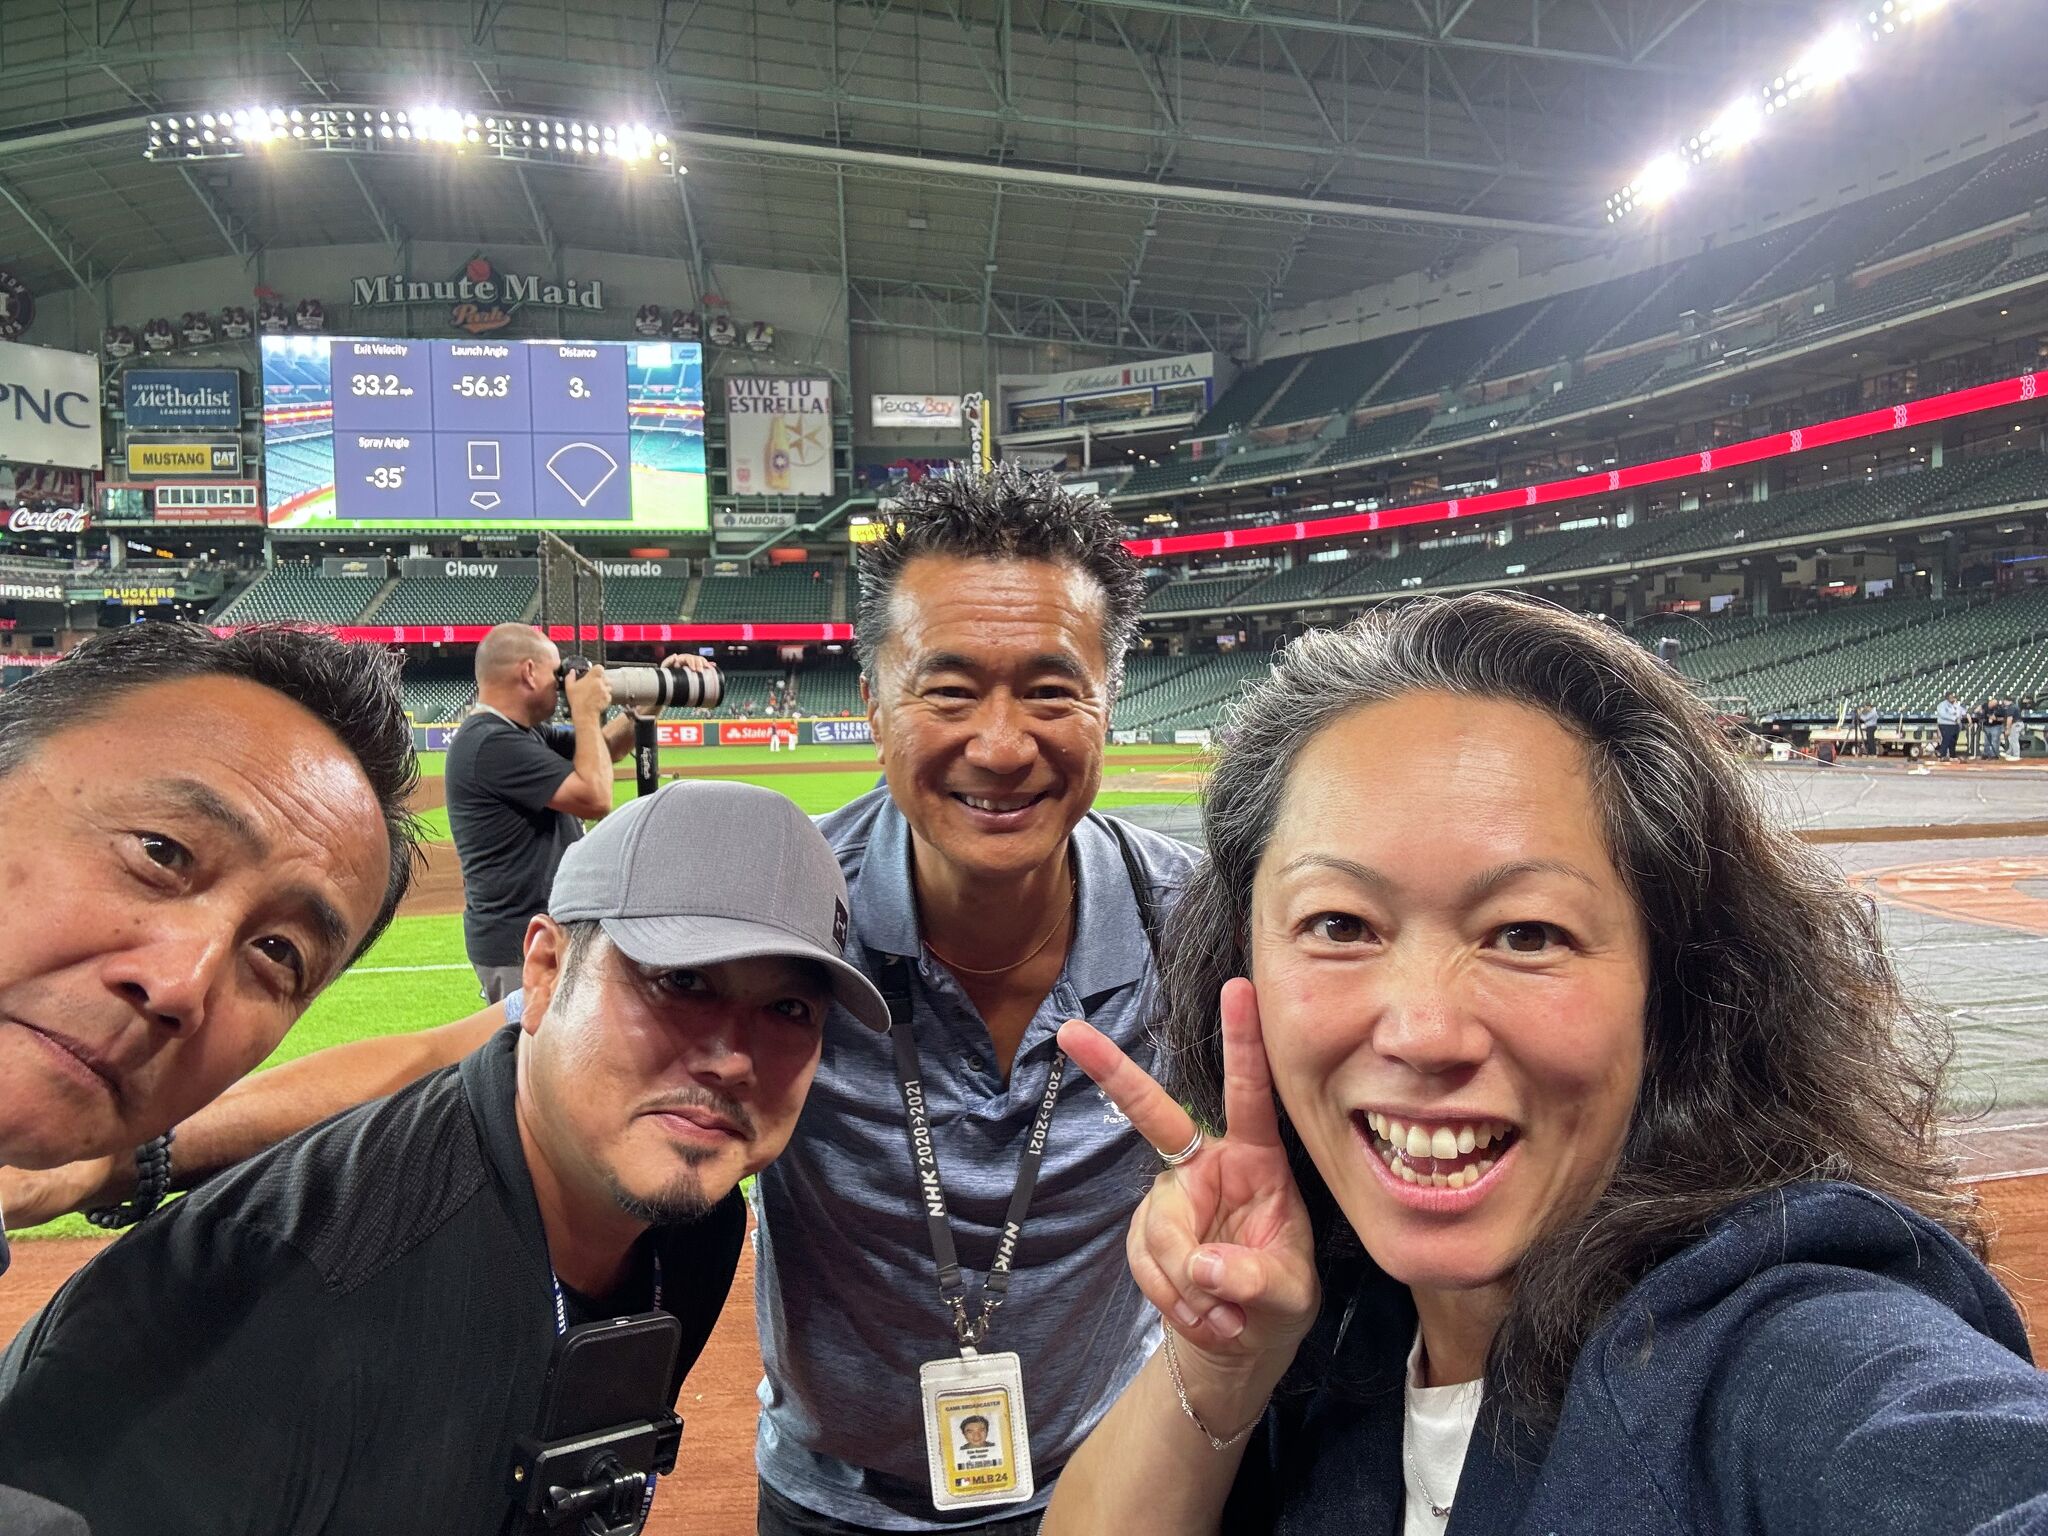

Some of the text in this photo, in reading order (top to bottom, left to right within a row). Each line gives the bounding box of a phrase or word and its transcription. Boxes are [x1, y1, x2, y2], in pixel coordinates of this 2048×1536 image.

[353, 274, 604, 310] Minute Maid
[354, 344, 407, 357] Exit Velocity
[451, 345, 508, 358] Launch Angle
[559, 347, 597, 358] Distance
[1134, 362, 1196, 384] ULTRA
[352, 374, 398, 395] 33.2
[784, 380, 811, 397] TU
[133, 387, 231, 407] Methodist
[729, 397, 830, 414] ESTRELLA!
[878, 396, 954, 416] Texas Bay
[359, 437, 410, 450] Spray Angle
[143, 451, 236, 466] MUSTANG CAT
[739, 516, 785, 525] NABORS
[445, 560, 661, 578] Chevy ilverado
[104, 587, 175, 599] PLUCKERS
[834, 722, 870, 731] ENERG
[921, 1170, 945, 1217] NHK
[995, 1221, 1020, 1271] NHK
[556, 1291, 566, 1335] LEAGUE
